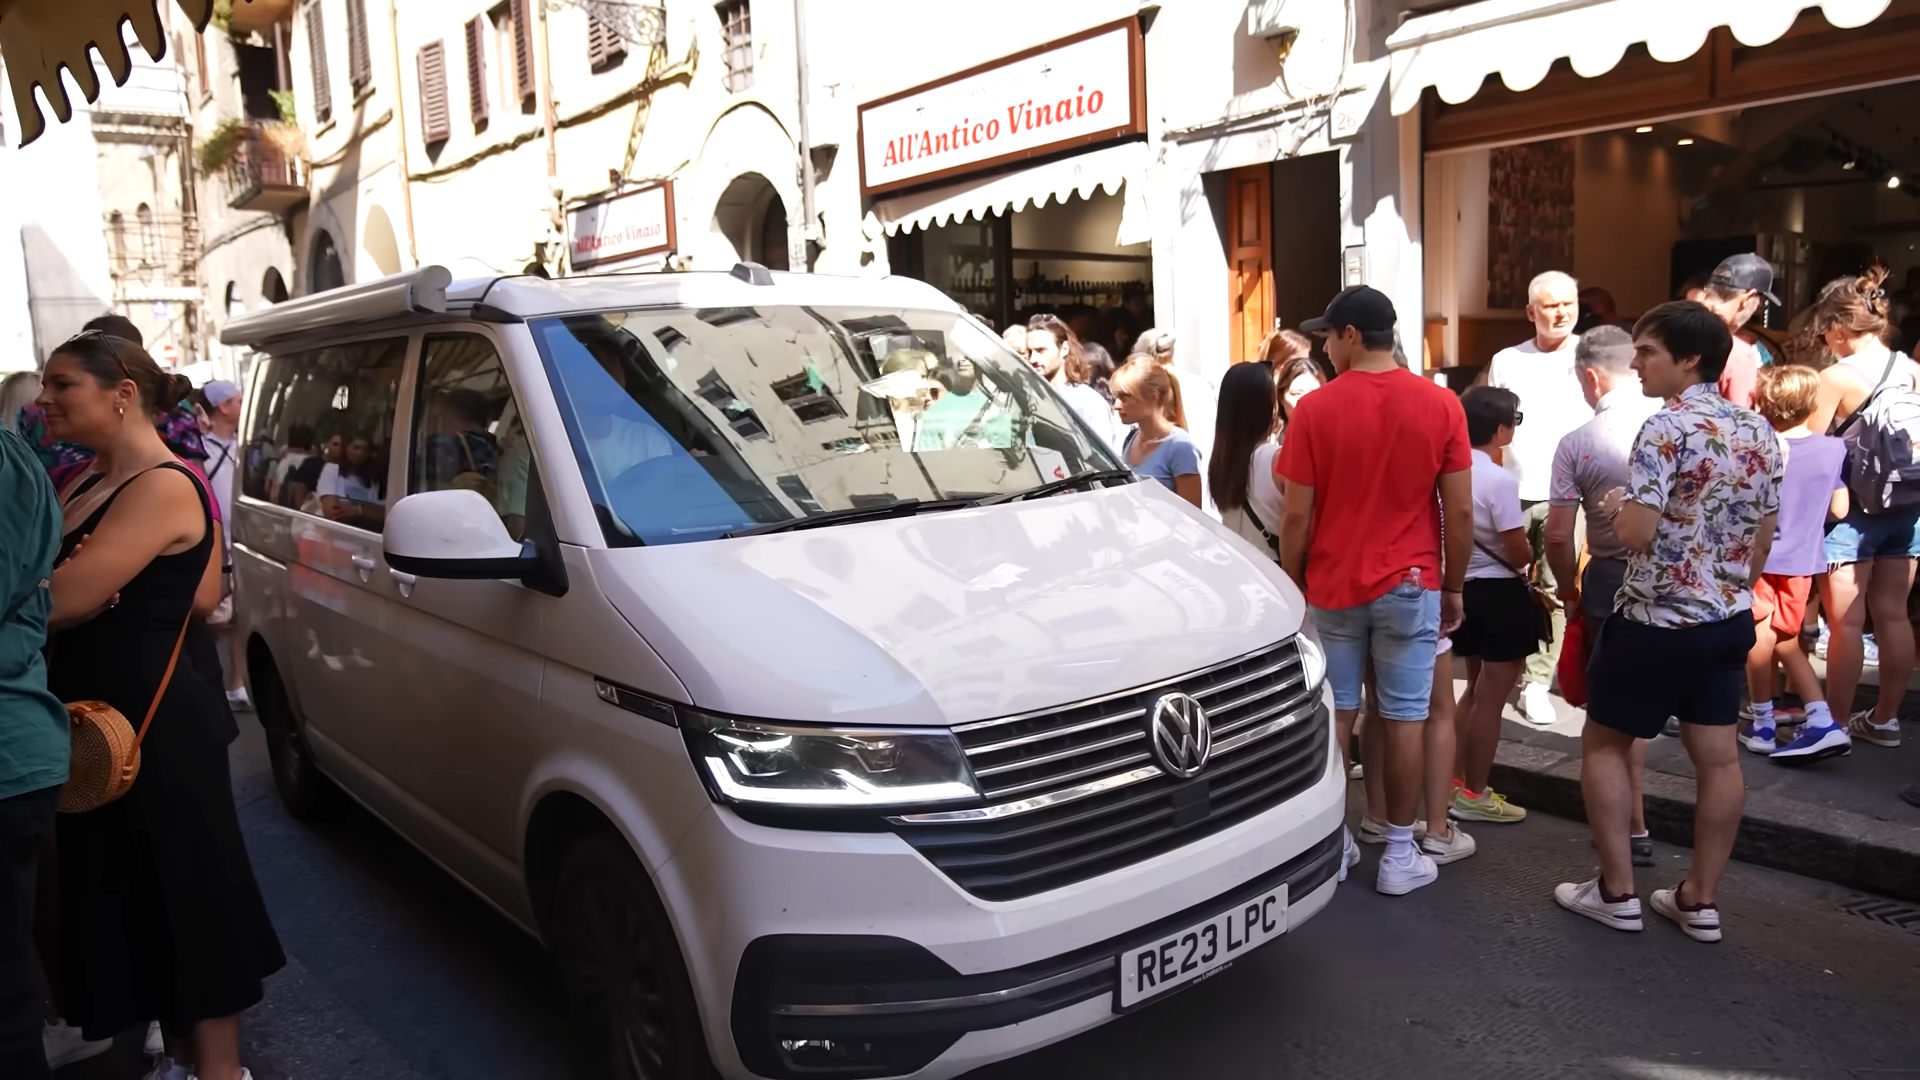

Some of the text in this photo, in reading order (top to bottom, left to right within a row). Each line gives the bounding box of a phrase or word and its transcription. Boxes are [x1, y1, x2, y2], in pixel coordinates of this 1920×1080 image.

[882, 84, 1104, 168] All'Antico Vinaio
[1336, 110, 1357, 132] 26
[625, 220, 661, 242] Vinaio
[1137, 895, 1277, 993] RE23 LPC
